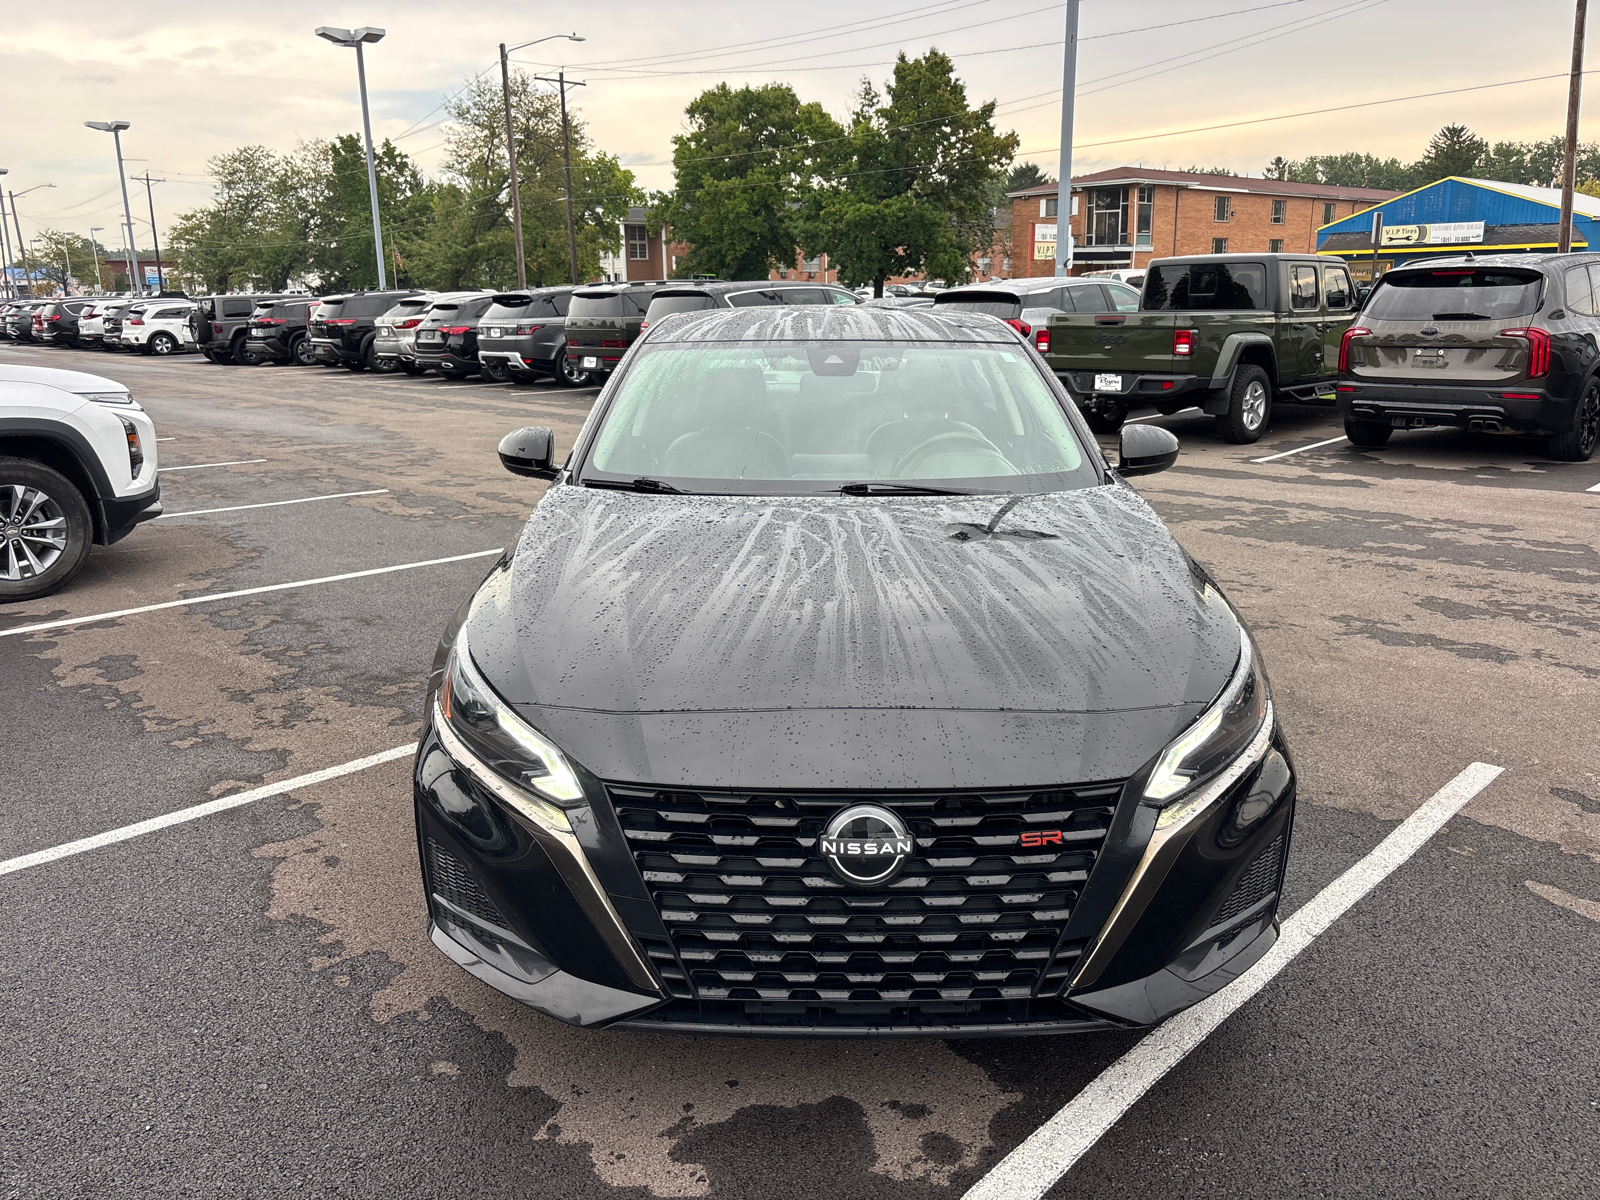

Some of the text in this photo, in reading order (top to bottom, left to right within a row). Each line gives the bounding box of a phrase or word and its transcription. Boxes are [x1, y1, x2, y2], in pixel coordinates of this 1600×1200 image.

[1092, 331, 1125, 347] Jeep
[1021, 830, 1062, 847] SR
[822, 840, 911, 855] NISSAN
